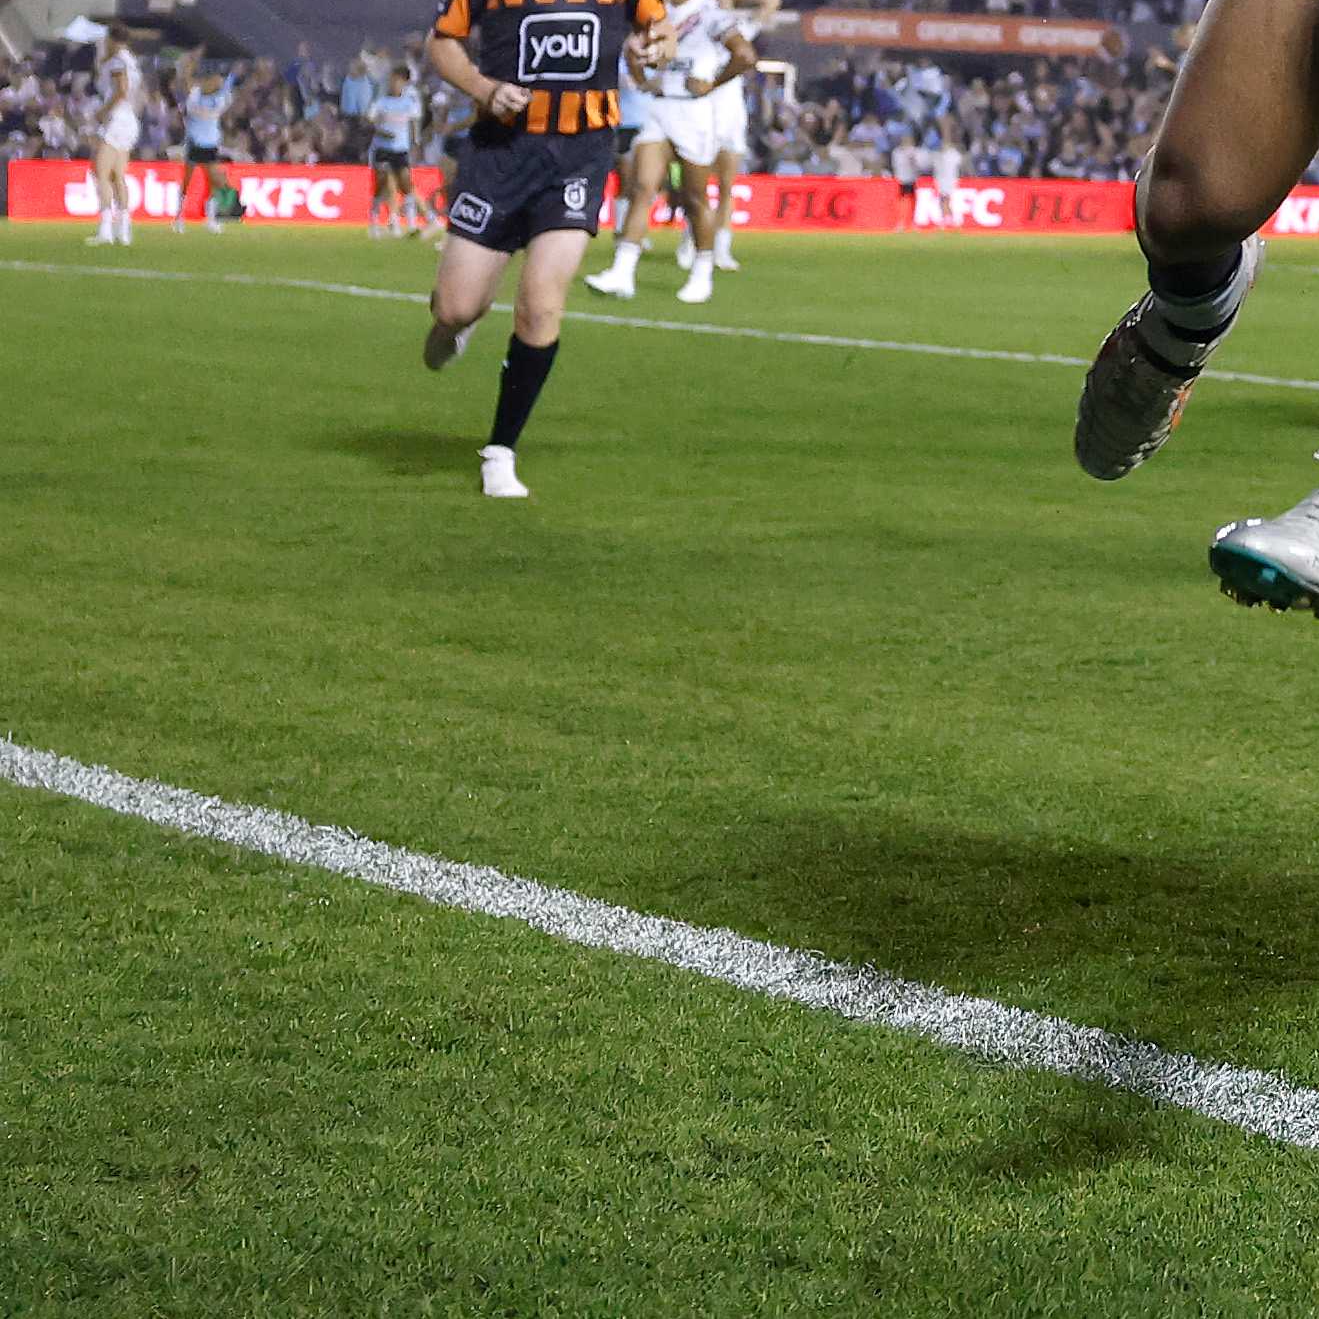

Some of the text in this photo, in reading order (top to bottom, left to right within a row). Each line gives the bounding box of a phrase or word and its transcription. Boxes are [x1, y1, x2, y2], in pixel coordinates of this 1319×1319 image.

[529, 24, 590, 68] youi
[239, 177, 344, 219] KFC
[914, 187, 1004, 227] KFC
